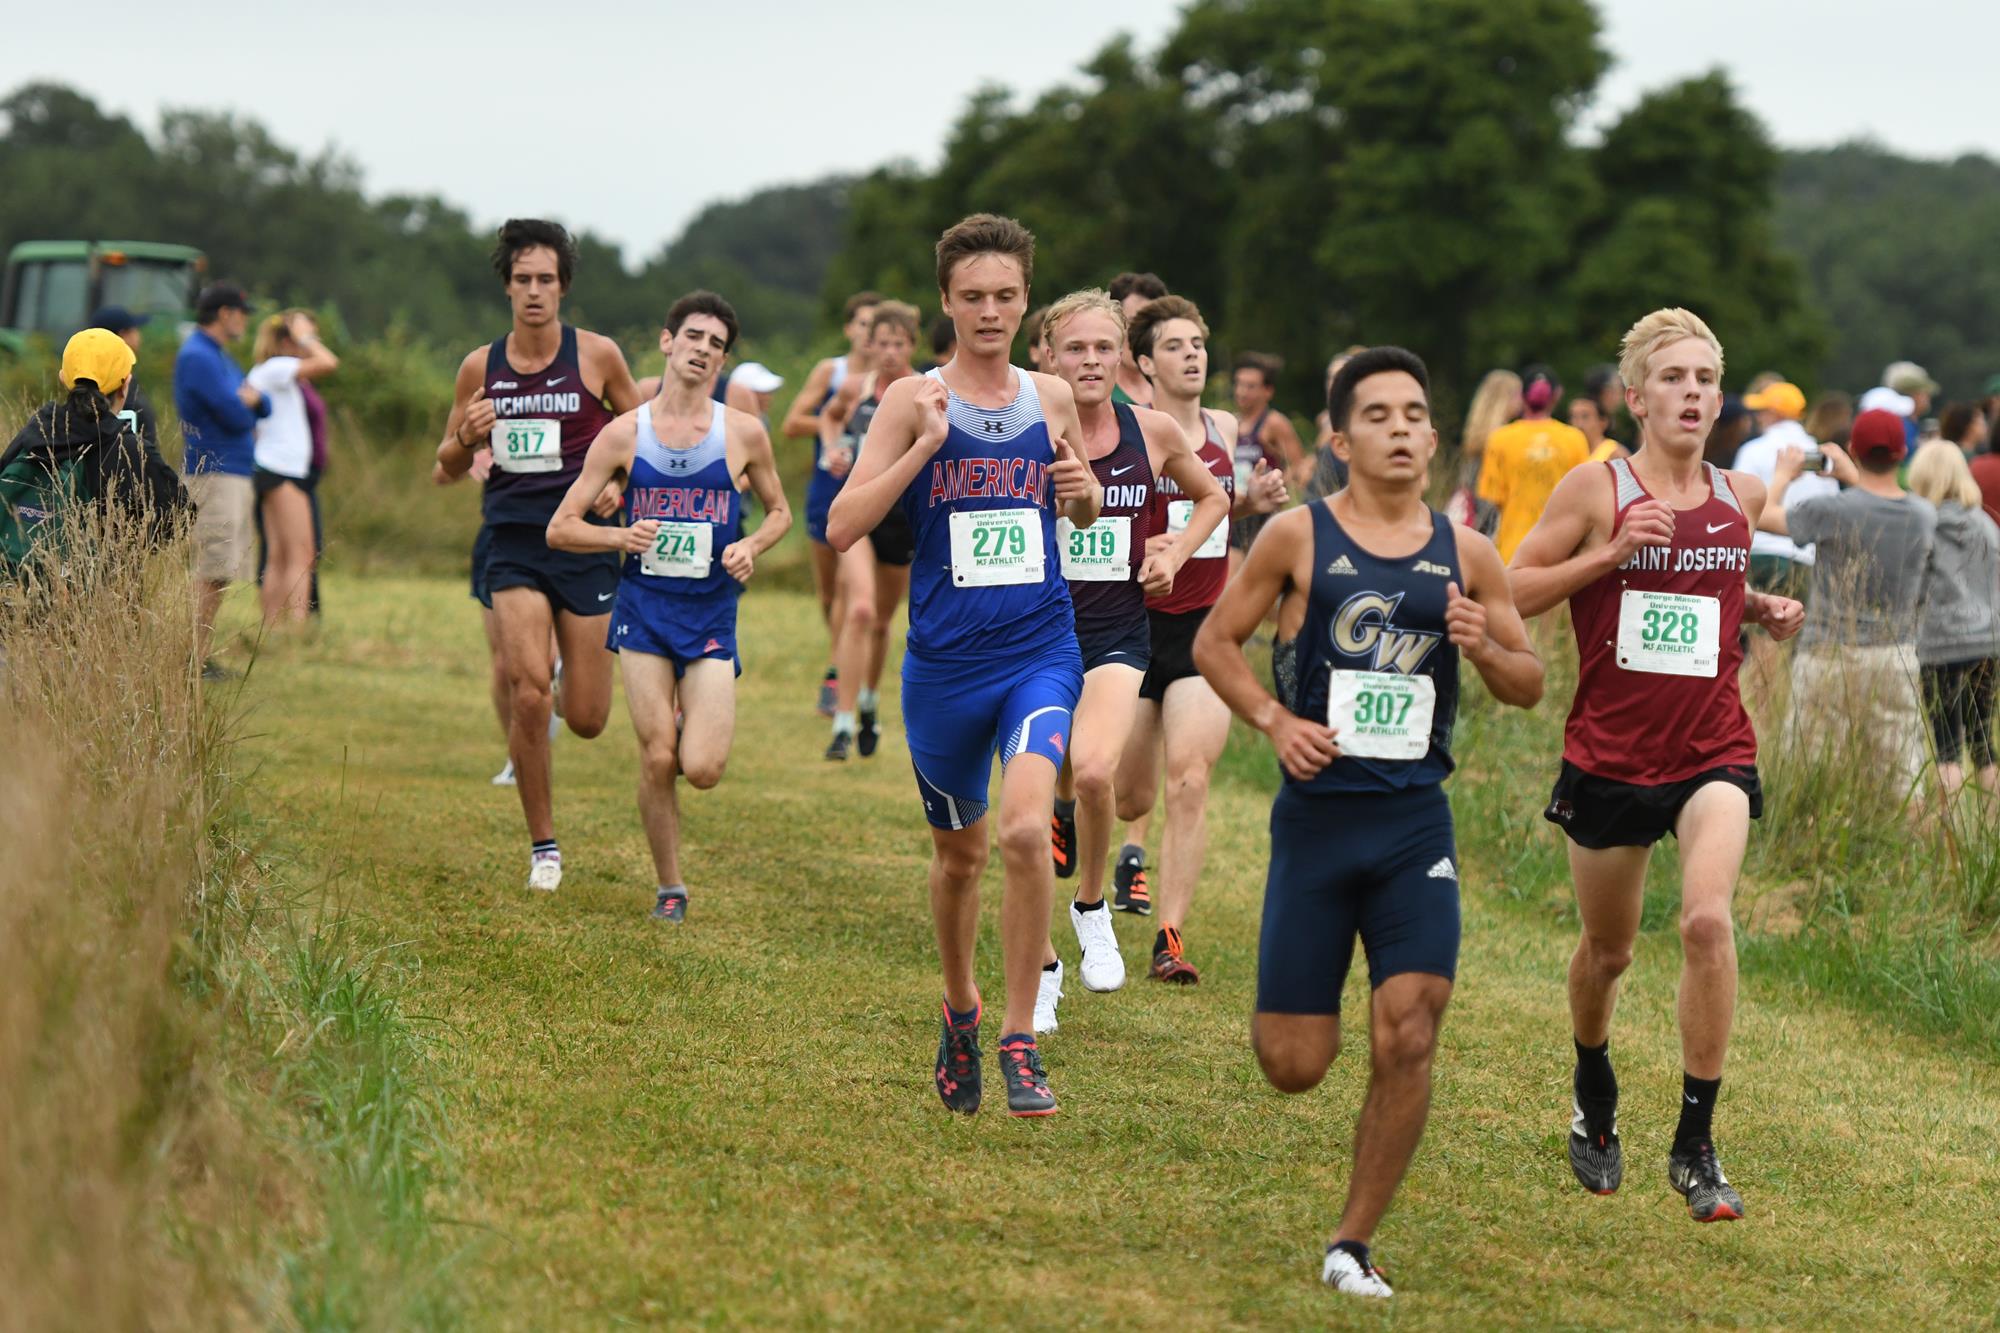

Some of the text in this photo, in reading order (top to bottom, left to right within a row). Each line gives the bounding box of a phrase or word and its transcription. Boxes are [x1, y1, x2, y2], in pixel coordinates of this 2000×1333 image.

[494, 392, 580, 415] ICHMOND
[506, 432, 545, 452] 317
[929, 457, 1048, 509] AMERICAN
[632, 487, 731, 525] AMERICAN
[656, 534, 696, 556] 274
[972, 525, 1026, 557] 279
[1069, 531, 1115, 556] 319
[989, 556, 1025, 565] ATHLETIC
[1674, 547, 1748, 572] JOSEPH'S
[1642, 593, 1701, 603] George Mason
[1650, 602, 1692, 612] University
[1642, 609, 1698, 644] 328
[1656, 644, 1695, 653] ATHLETIC
[1354, 691, 1415, 726] 307
[1369, 726, 1409, 736] ATHLETIC
